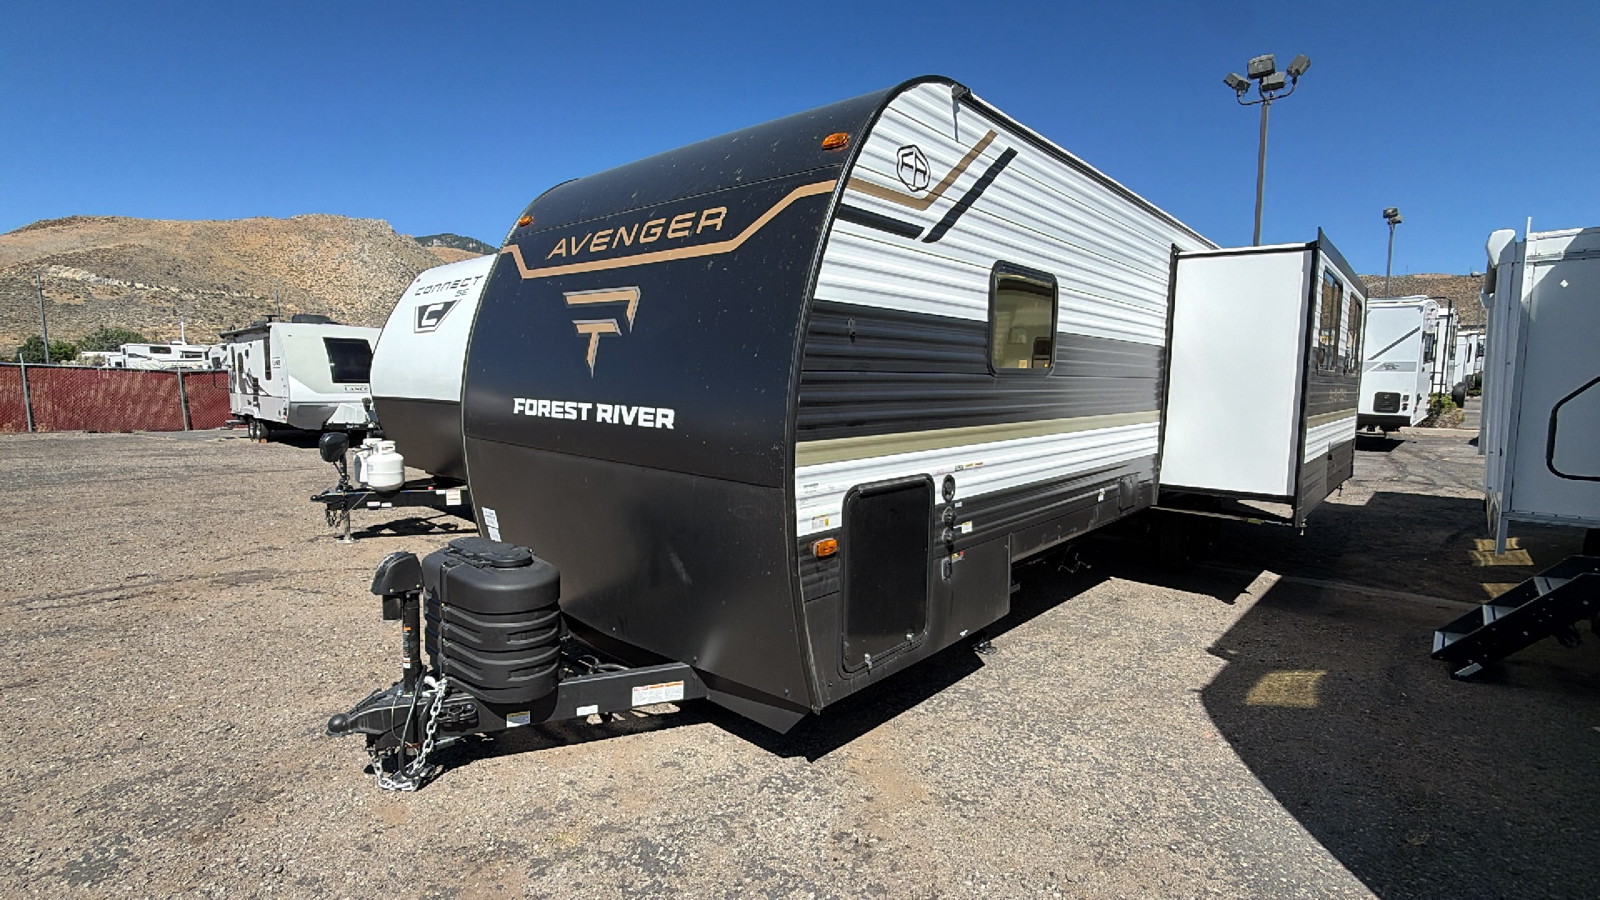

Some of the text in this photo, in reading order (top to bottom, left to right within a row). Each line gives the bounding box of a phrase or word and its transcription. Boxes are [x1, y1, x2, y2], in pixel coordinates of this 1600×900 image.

[546, 205, 728, 260] AVENGER
[414, 274, 484, 297] CONNECT
[513, 397, 676, 430] FOREST RIVER
